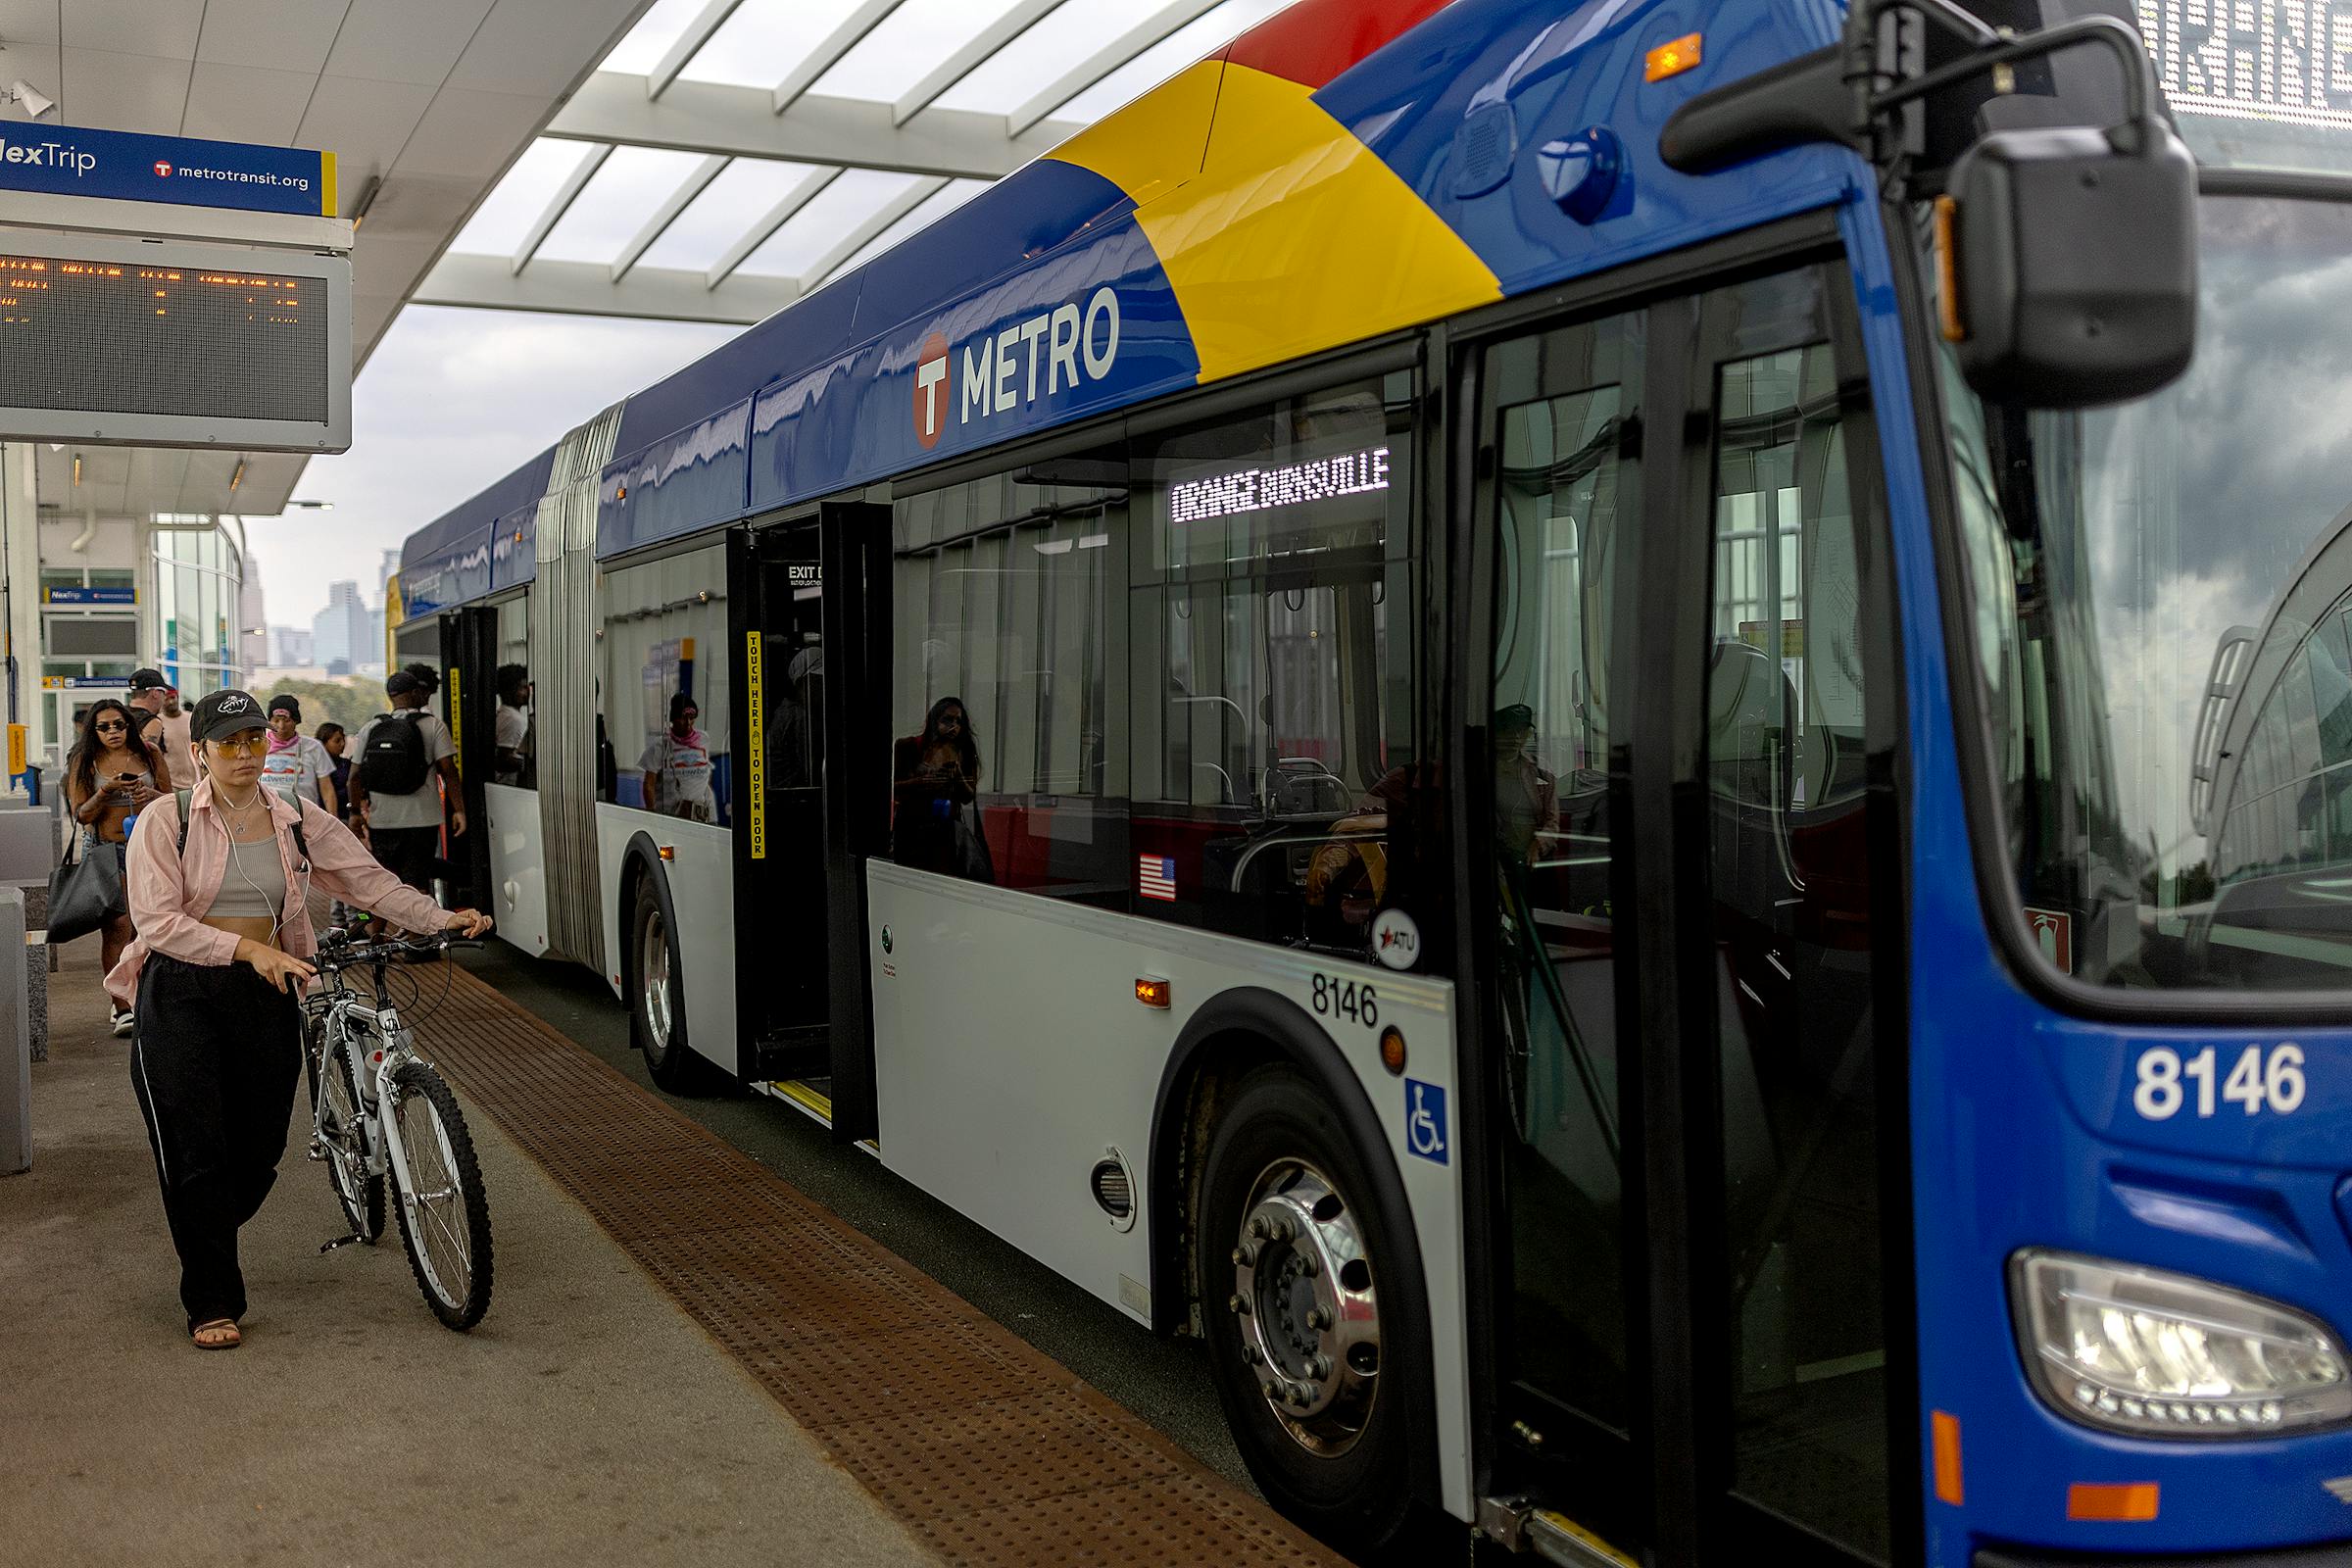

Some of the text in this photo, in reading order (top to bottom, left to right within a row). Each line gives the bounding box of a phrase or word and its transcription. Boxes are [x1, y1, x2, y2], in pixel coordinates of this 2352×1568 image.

[0, 139, 96, 177] exTrip
[178, 166, 309, 191] metrotransit.org
[960, 286, 1120, 424] METRO
[1171, 467, 1260, 523] ORANGE
[788, 565, 815, 579] EXIT
[750, 636, 759, 684] TOUCH
[753, 749, 760, 768] TO
[1392, 930, 1416, 952] ATU
[1312, 972, 1378, 1029] 8146
[2133, 1041, 2306, 1121] 8146
